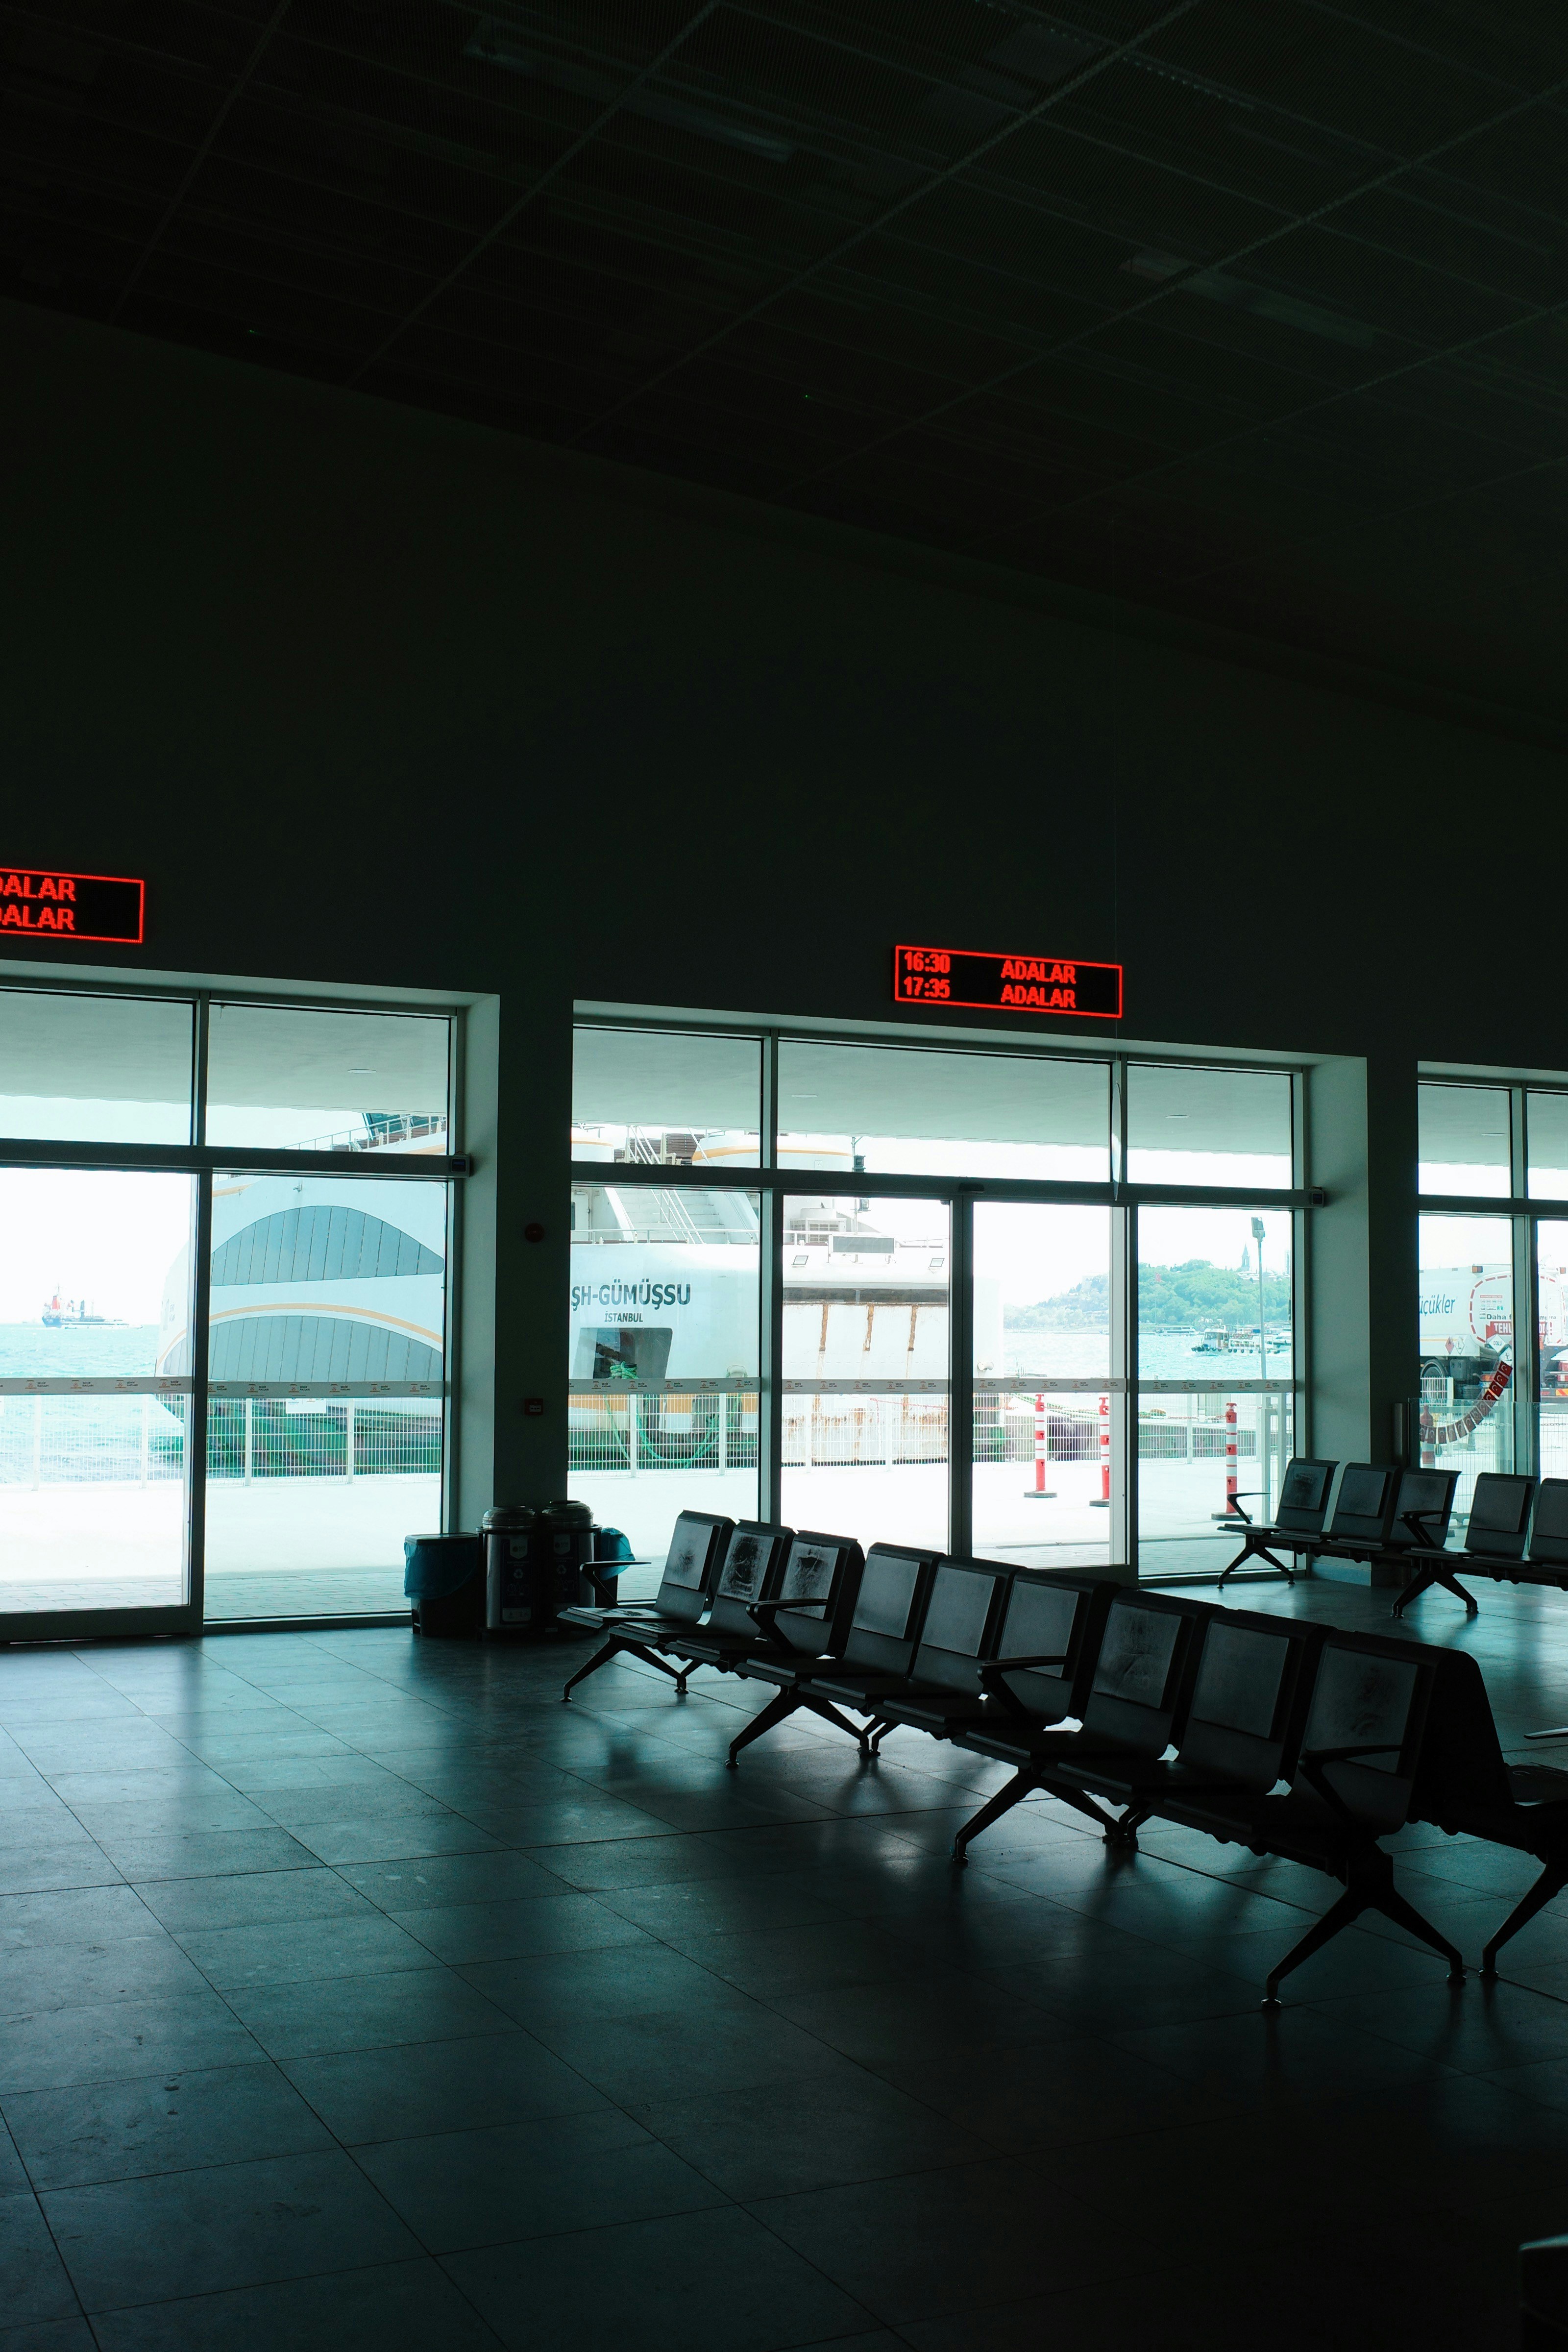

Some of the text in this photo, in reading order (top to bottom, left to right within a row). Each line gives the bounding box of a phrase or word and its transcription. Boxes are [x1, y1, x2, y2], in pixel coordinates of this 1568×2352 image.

[0, 904, 75, 931] ALAR
[904, 952, 1077, 984] 16:30 ADALAR
[904, 977, 1077, 1008] 17:35 ADALAR
[604, 1310, 643, 1322] İSTANBUL
